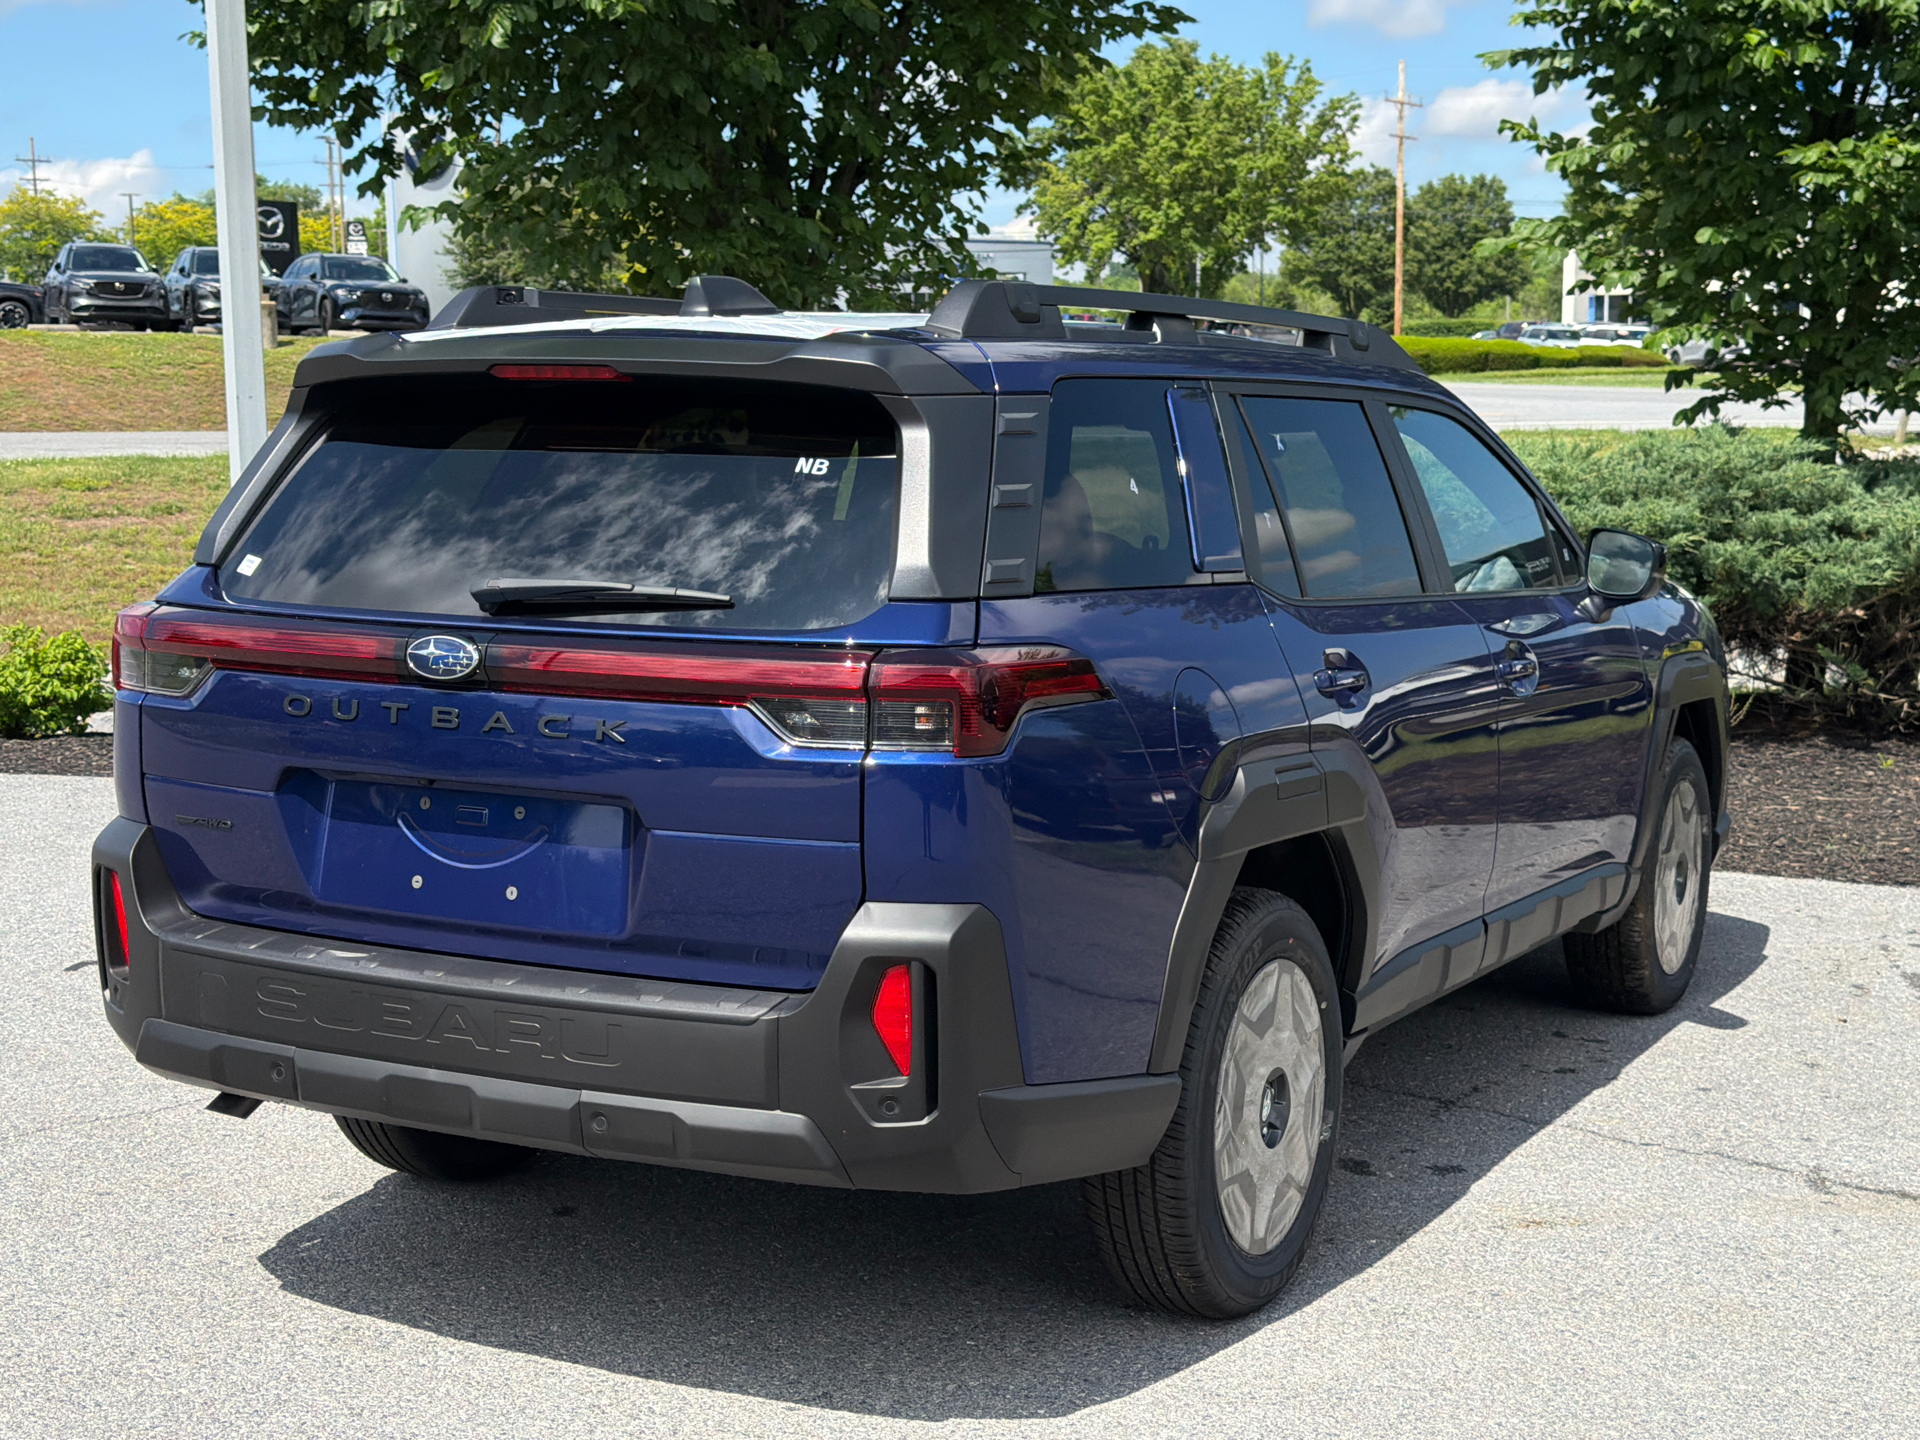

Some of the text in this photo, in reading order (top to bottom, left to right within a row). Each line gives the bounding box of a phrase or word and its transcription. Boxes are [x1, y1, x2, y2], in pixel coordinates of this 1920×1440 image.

[794, 456, 830, 476] NB
[283, 693, 627, 743] OUTBACK
[256, 976, 623, 1067] SUBARU
